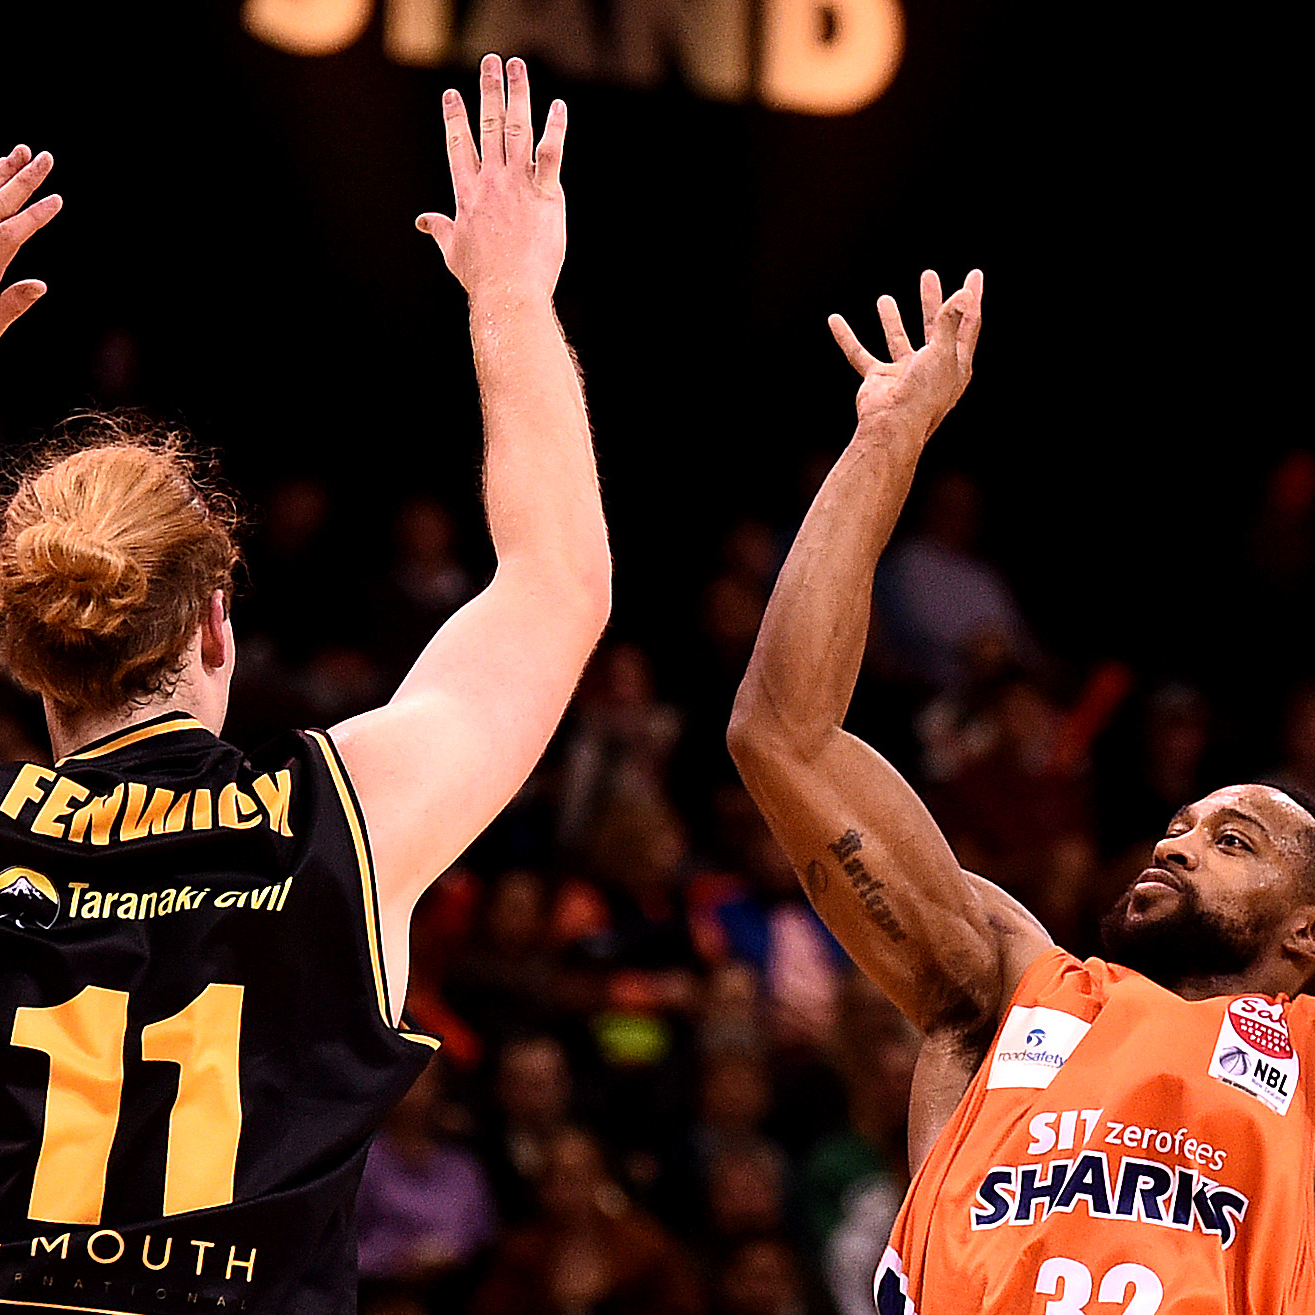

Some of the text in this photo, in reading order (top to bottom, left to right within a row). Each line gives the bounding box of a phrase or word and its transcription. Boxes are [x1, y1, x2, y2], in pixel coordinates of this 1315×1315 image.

[68, 881, 211, 920] Taranaki
[1253, 1059, 1288, 1097] NBL
[10, 982, 245, 1226] 11
[1104, 1121, 1228, 1171] zerofees
[971, 1150, 1250, 1251] SHARKS
